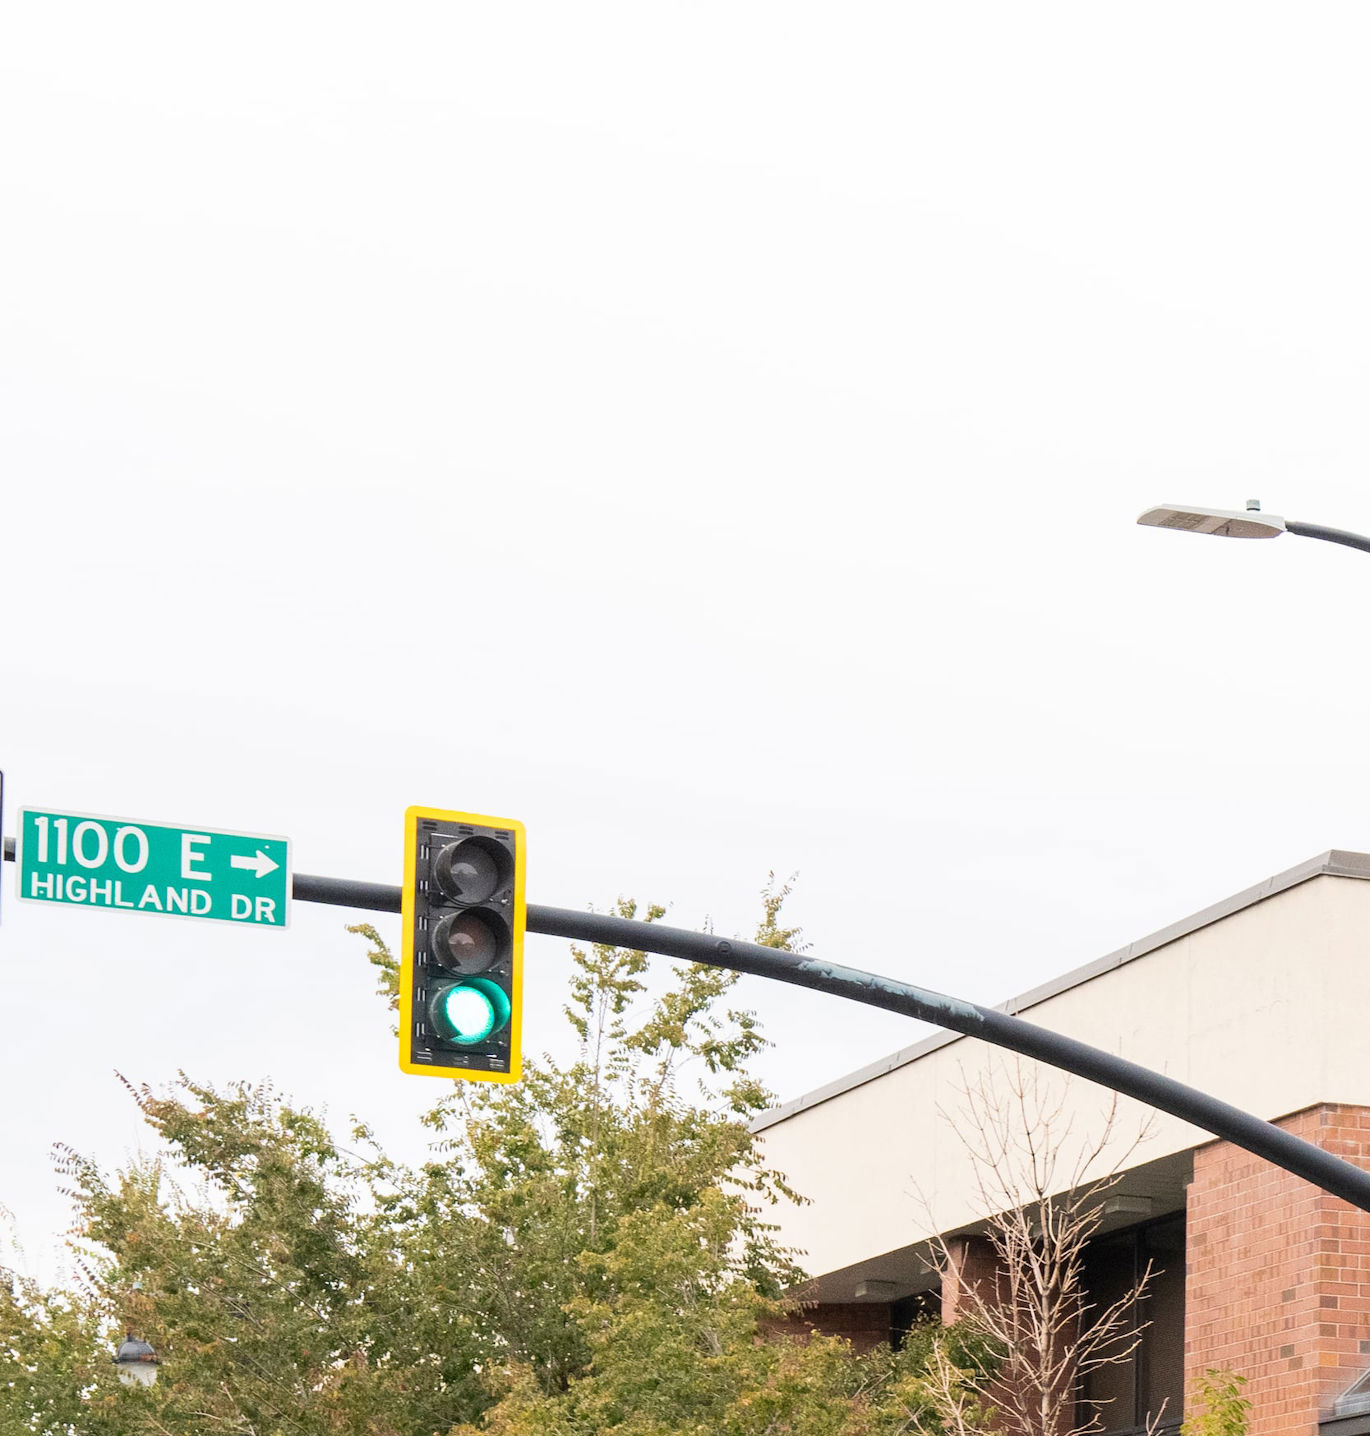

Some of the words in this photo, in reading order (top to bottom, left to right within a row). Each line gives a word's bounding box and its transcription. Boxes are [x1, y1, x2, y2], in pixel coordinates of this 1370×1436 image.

[34, 815, 149, 874] 1100
[181, 832, 212, 882] E
[31, 871, 213, 915] HIGHLAND
[231, 893, 276, 923] DR
